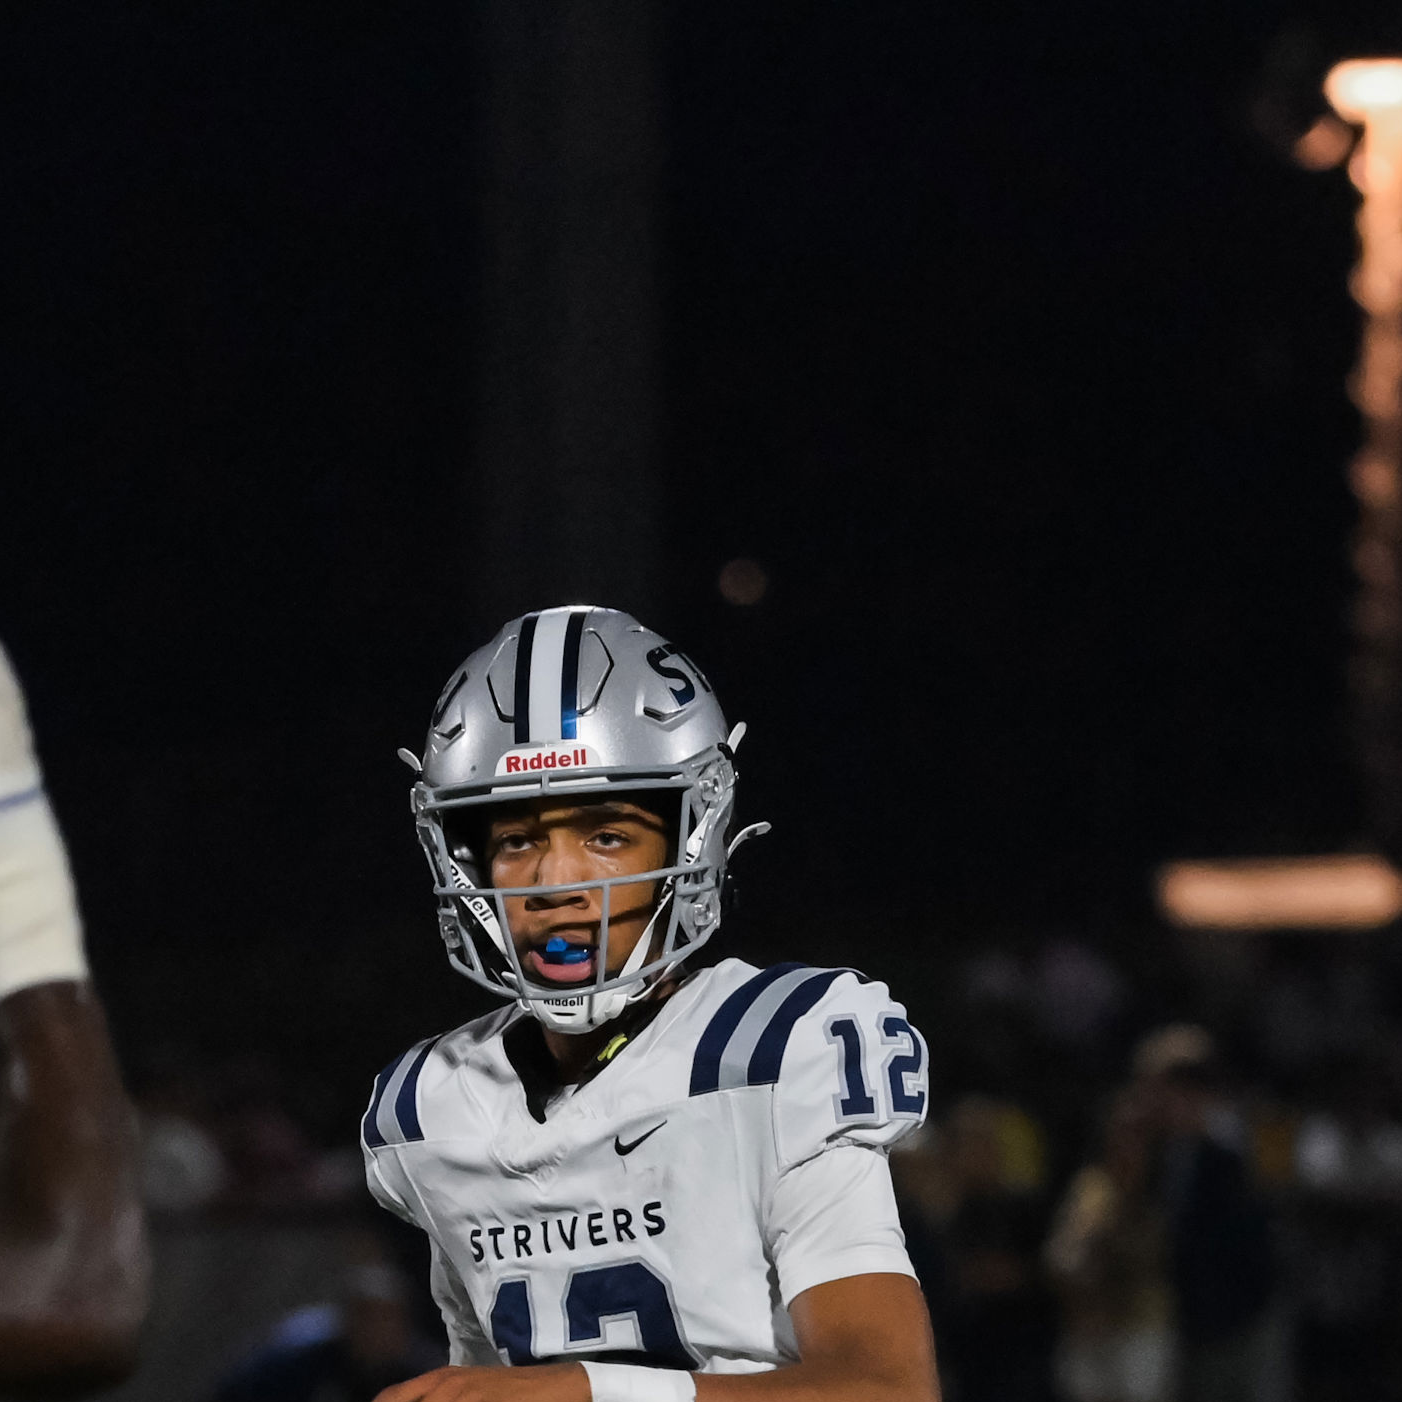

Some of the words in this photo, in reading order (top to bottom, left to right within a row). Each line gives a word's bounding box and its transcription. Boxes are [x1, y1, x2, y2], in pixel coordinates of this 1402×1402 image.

[506, 749, 587, 773] Riddell
[822, 1011, 927, 1124] 12
[470, 1201, 667, 1262] STRIVERS
